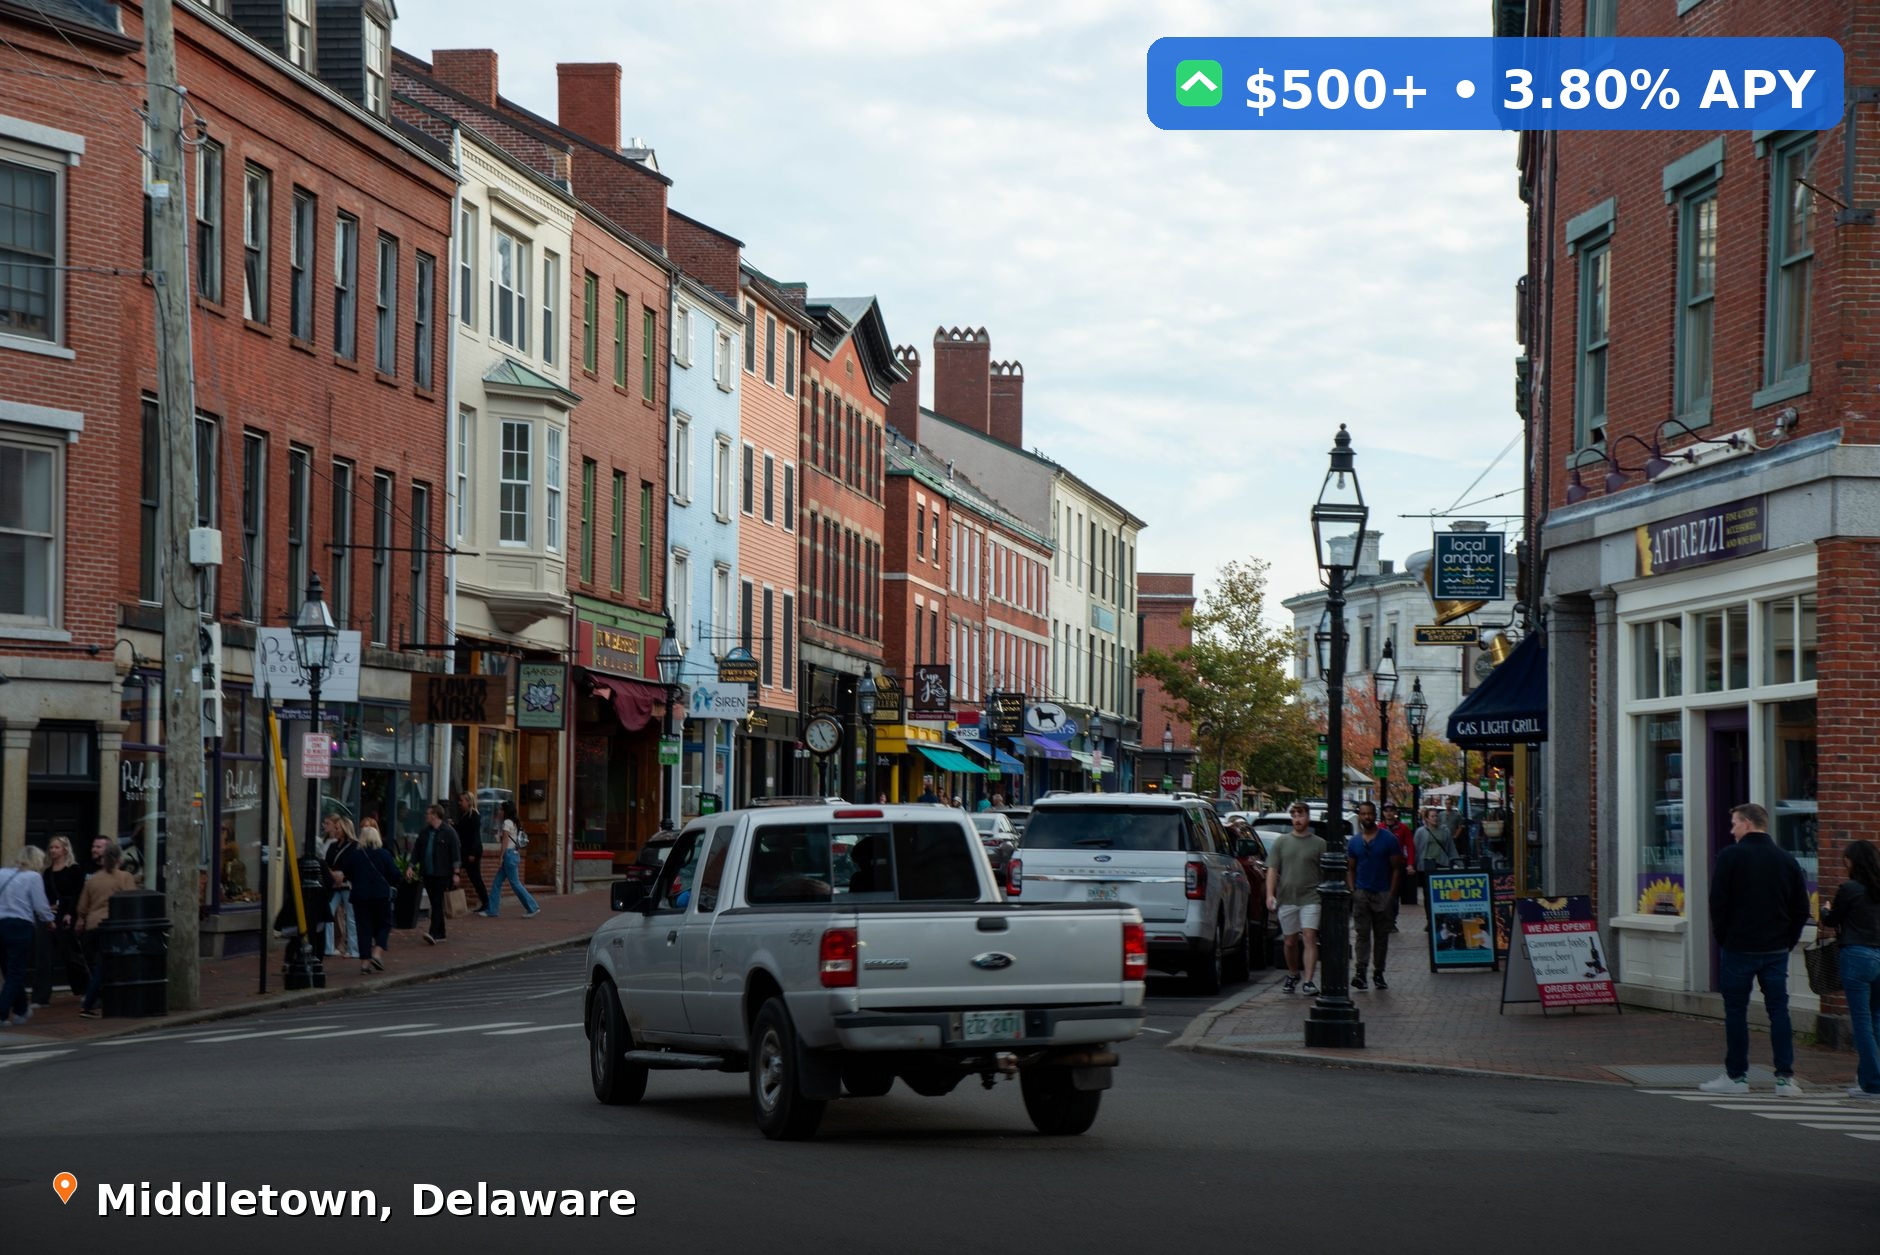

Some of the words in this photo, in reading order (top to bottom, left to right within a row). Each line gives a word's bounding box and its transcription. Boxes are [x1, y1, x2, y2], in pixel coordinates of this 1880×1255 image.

[1451, 537, 1486, 551] local
[1653, 515, 1725, 565] ATTREZZI
[1442, 550, 1495, 564] anchor
[428, 677, 488, 697] FLOWER
[427, 695, 488, 722] KIOSK
[715, 697, 746, 708] SIREN
[1456, 721, 1479, 735] GAS
[1480, 719, 1511, 735] LIGHT
[1511, 718, 1543, 733] GRILL
[121, 760, 164, 793] Prelude
[1220, 776, 1242, 786] STOP
[225, 768, 258, 800] Prelude
[1432, 878, 1486, 890] HAPPY
[1439, 888, 1483, 901] HOUR
[1528, 924, 1542, 933] WE
[1543, 923, 1560, 932] ARE
[1543, 984, 1576, 994] ORDER
[1575, 982, 1609, 992] ONLINE
